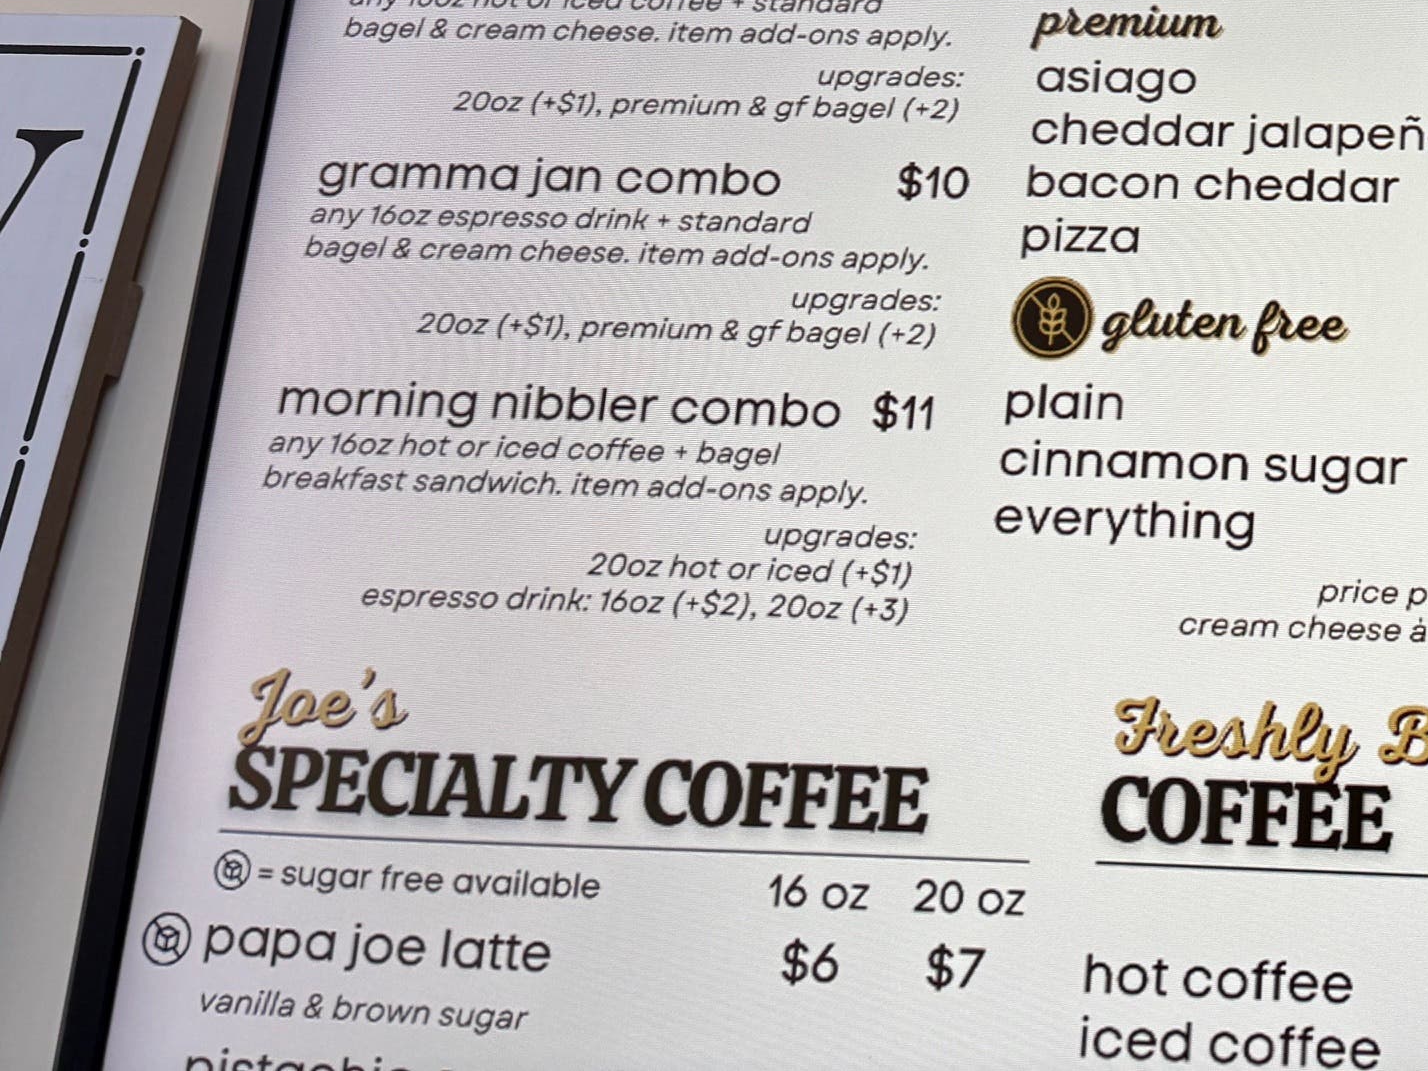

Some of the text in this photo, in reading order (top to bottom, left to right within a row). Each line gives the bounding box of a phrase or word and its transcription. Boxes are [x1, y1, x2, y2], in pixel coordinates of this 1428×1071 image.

[343, 16, 952, 53] bagel & cream cheese. item add-ons apply.
[1029, 4, 1225, 52] premium
[817, 65, 965, 93] upgrades:
[1036, 59, 1197, 104] asiago
[452, 89, 960, 125] 20oz (+$1), premium & gf bagel (+2)
[317, 156, 971, 202] gramma jan combo $10
[1020, 216, 1141, 260] pizza
[1100, 296, 1351, 358] gluten free
[277, 380, 935, 433] morning nibbler combo $11
[1004, 382, 1124, 427] plain
[262, 464, 868, 510] breakfast sandwich. item add-ons apply.
[993, 499, 1256, 552] everything
[360, 585, 910, 627] espresso drink: 16oz (+$2), 20oz (+3)
[1316, 578, 1399, 609] price
[1178, 616, 1280, 639] cream
[1287, 614, 1402, 643] cheese
[237, 666, 410, 747] Joe's
[1113, 695, 1361, 786] Freshly
[228, 744, 931, 837] SPECIALTY COFFEE
[1099, 774, 1394, 854] COFFEE
[768, 873, 1027, 917] 16 oz 20 oz
[202, 922, 987, 993] papa joe latte $6 $7
[1083, 952, 1170, 998] hot
[1182, 958, 1354, 1006] coffee
[200, 989, 530, 1036] vanilla & brown sugar
